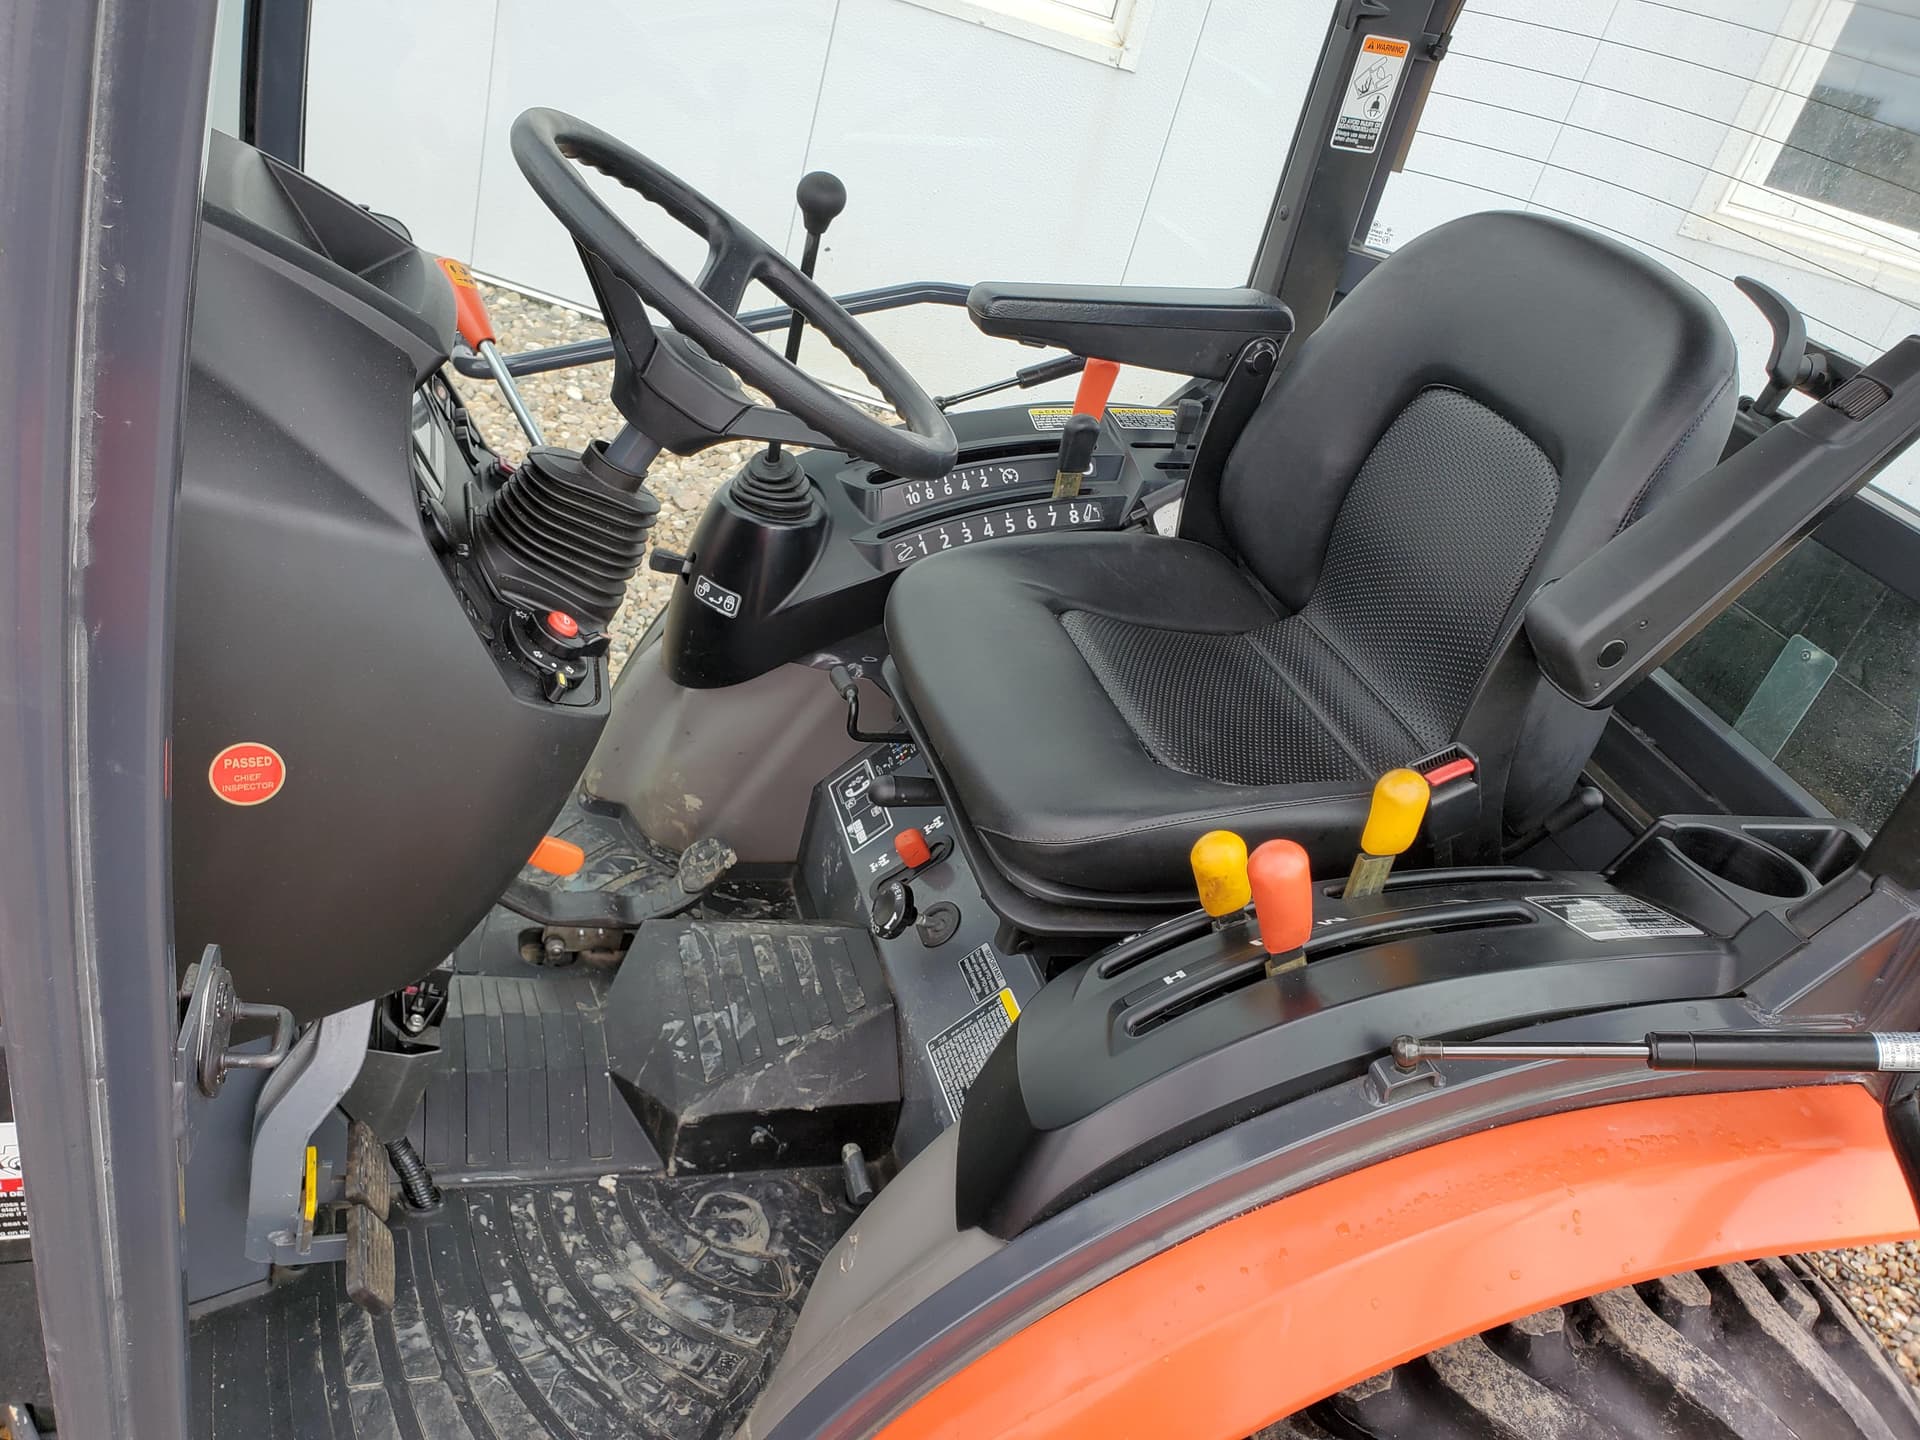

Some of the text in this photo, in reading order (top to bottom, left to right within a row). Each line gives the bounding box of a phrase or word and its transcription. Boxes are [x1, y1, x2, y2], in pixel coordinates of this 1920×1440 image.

[1376, 43, 1404, 54] WARNING
[905, 476, 989, 505] 10 8 6 4 2
[919, 510, 1080, 555] 1 2 3 4 5 6 7 8
[224, 756, 272, 769] PASSED
[234, 773, 262, 782] CHIEF
[222, 782, 274, 792] INSPECTOR
